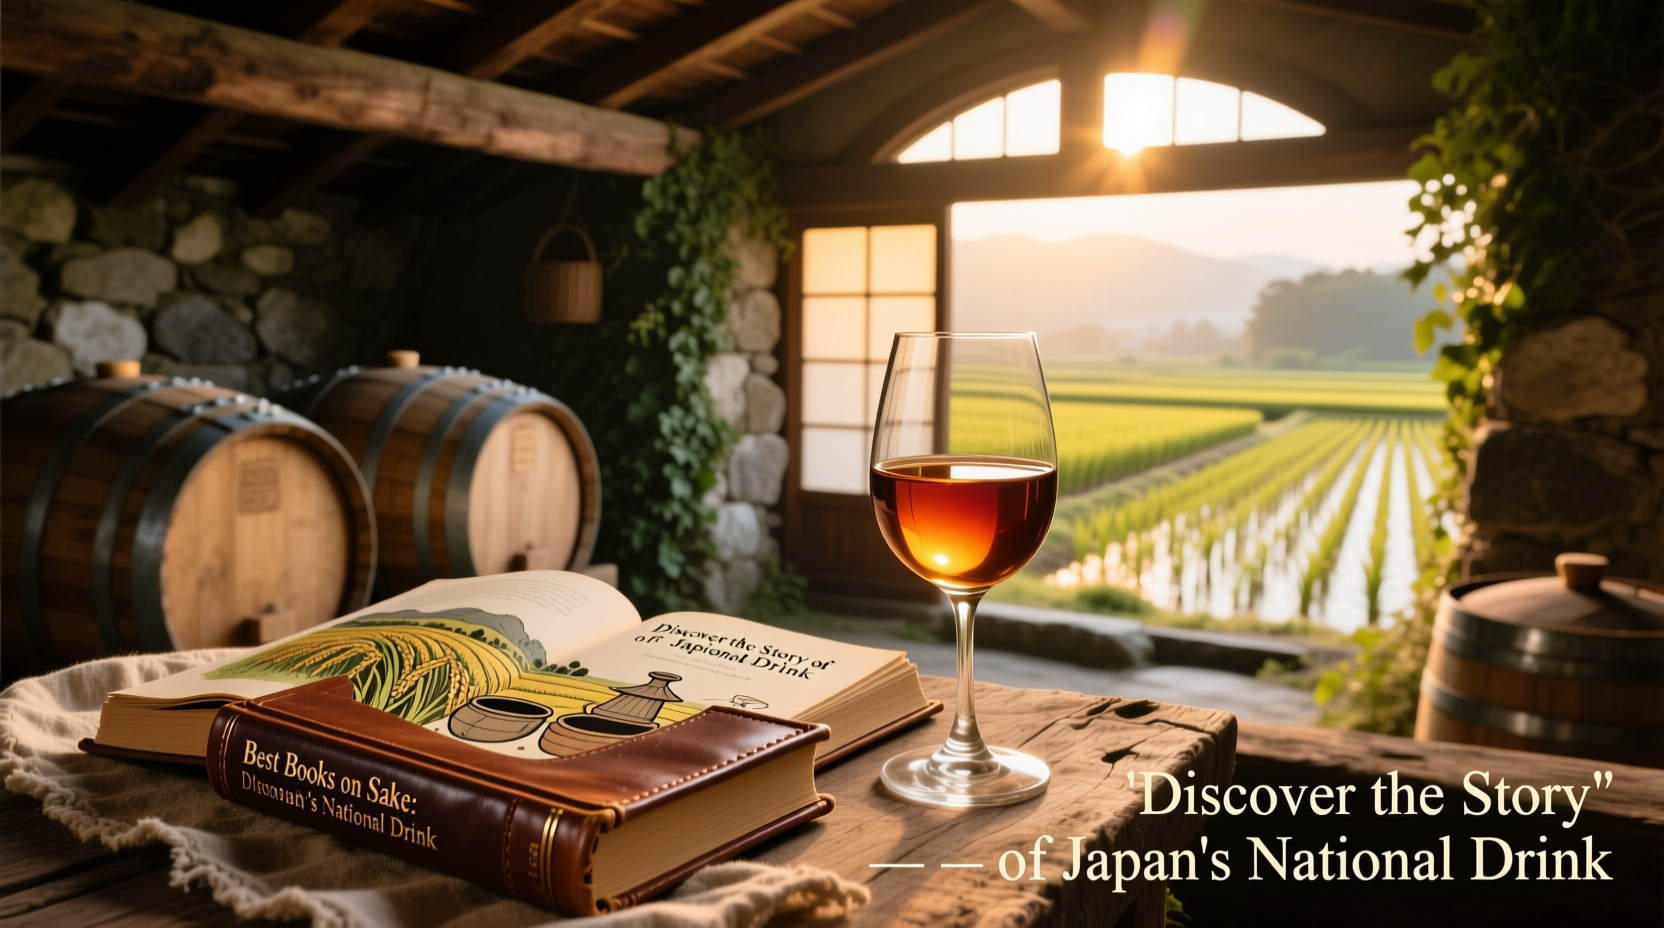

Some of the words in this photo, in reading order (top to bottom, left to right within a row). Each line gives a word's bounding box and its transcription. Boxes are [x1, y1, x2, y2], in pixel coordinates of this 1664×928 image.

[750, 656, 815, 680] Drink
[759, 645, 810, 666] Story
[242, 739, 281, 773] Best
[283, 750, 336, 790] Books
[340, 776, 362, 798] on
[366, 776, 417, 815] Sake:
[322, 794, 385, 834] National
[390, 816, 438, 850] Drink
